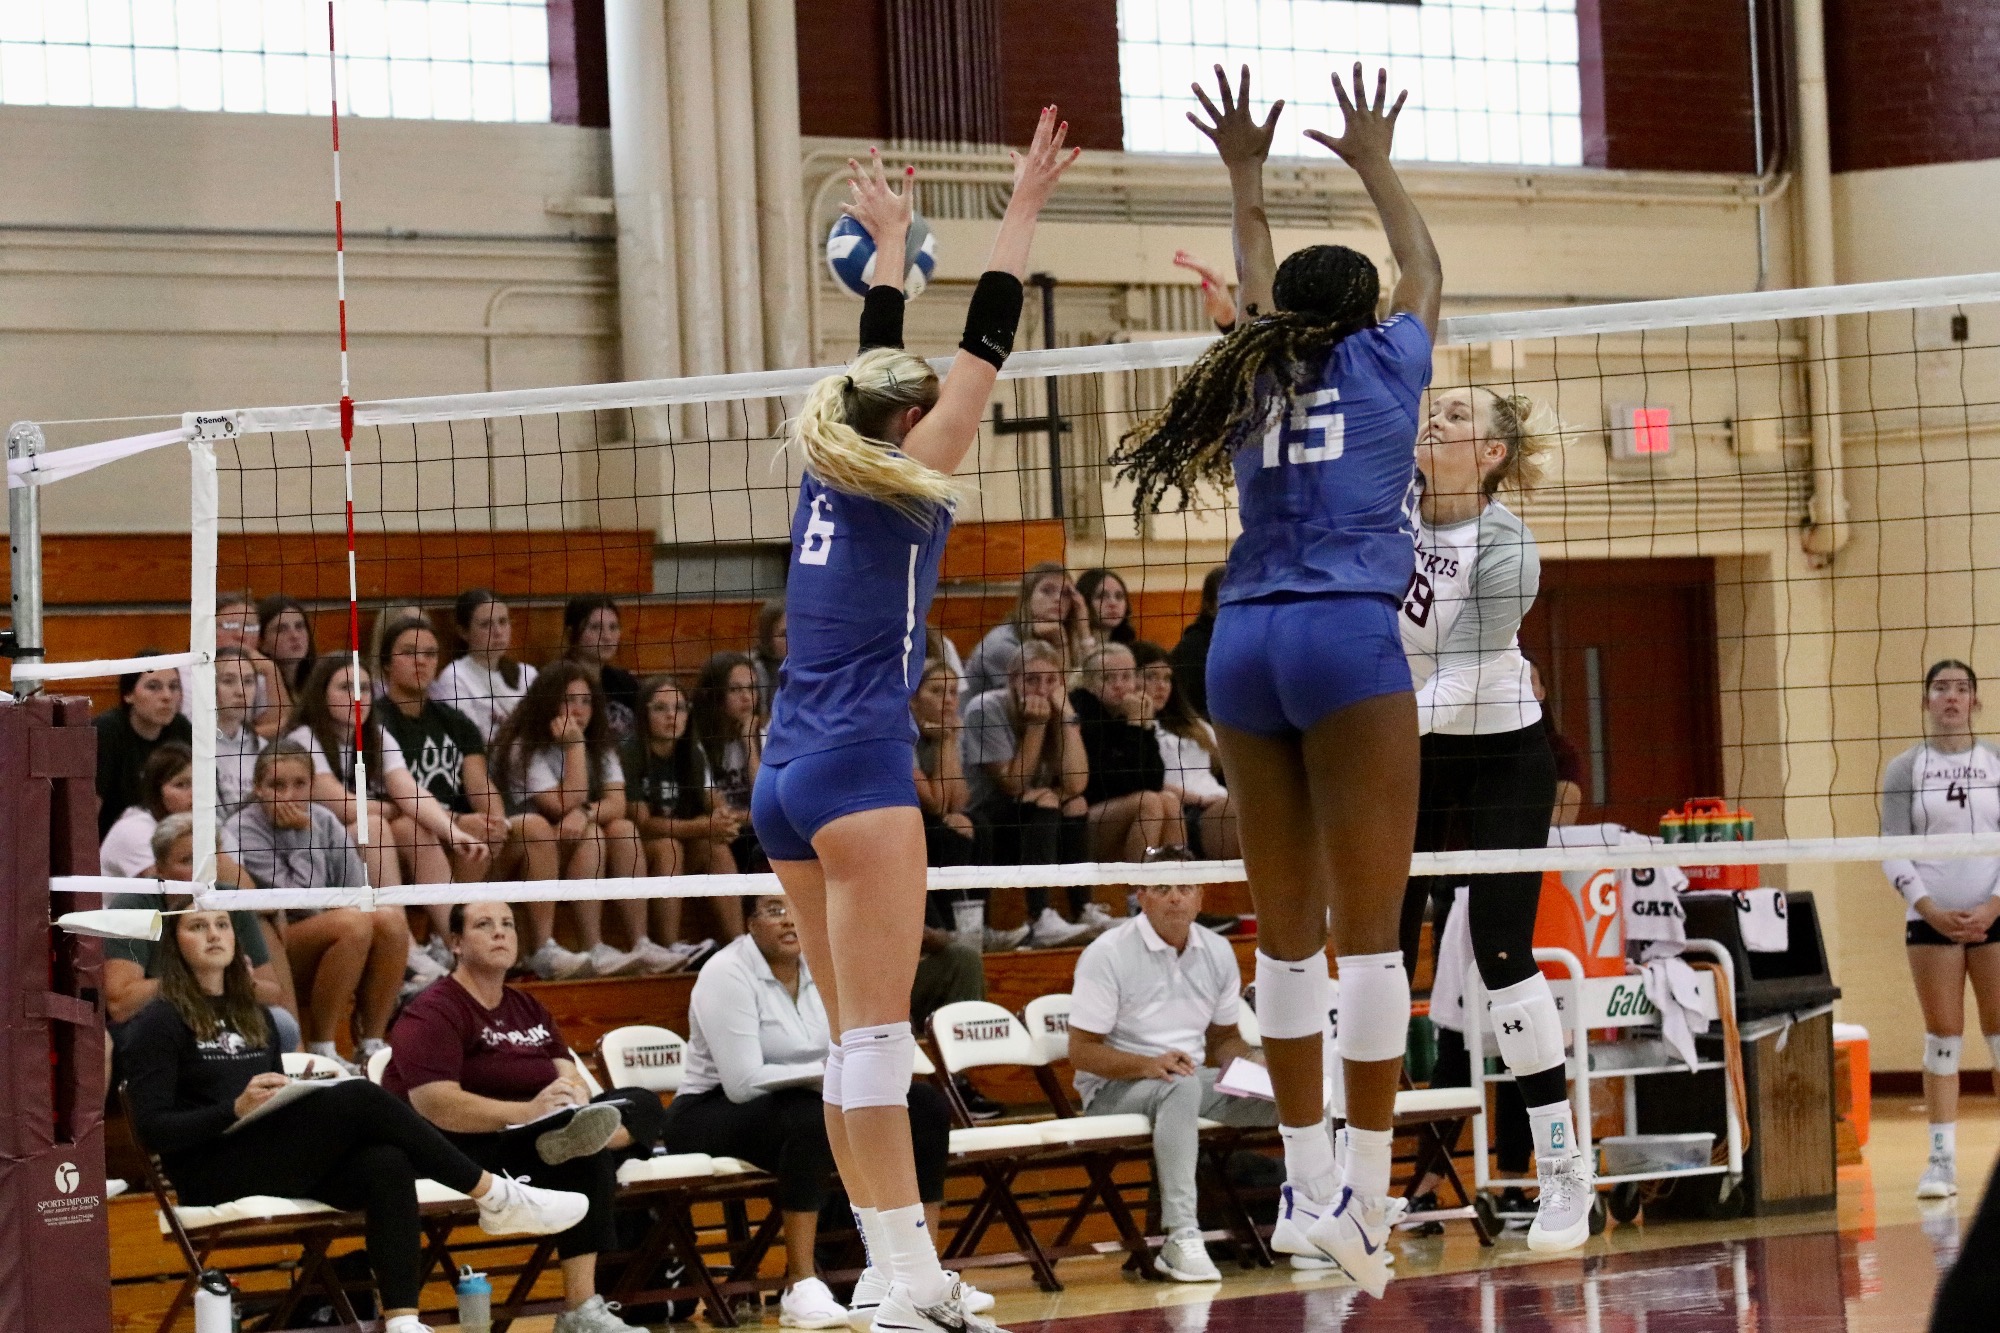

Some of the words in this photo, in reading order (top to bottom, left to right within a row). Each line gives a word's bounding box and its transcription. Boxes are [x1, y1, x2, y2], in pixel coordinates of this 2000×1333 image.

[202, 415, 228, 424] Senoh
[1262, 387, 1345, 469] 15
[799, 493, 835, 566] 6
[1946, 782, 1967, 808] 4
[1606, 983, 1655, 1017] Gato
[37, 1199, 66, 1212] SPORTS
[66, 1195, 100, 1207] IMPORTS
